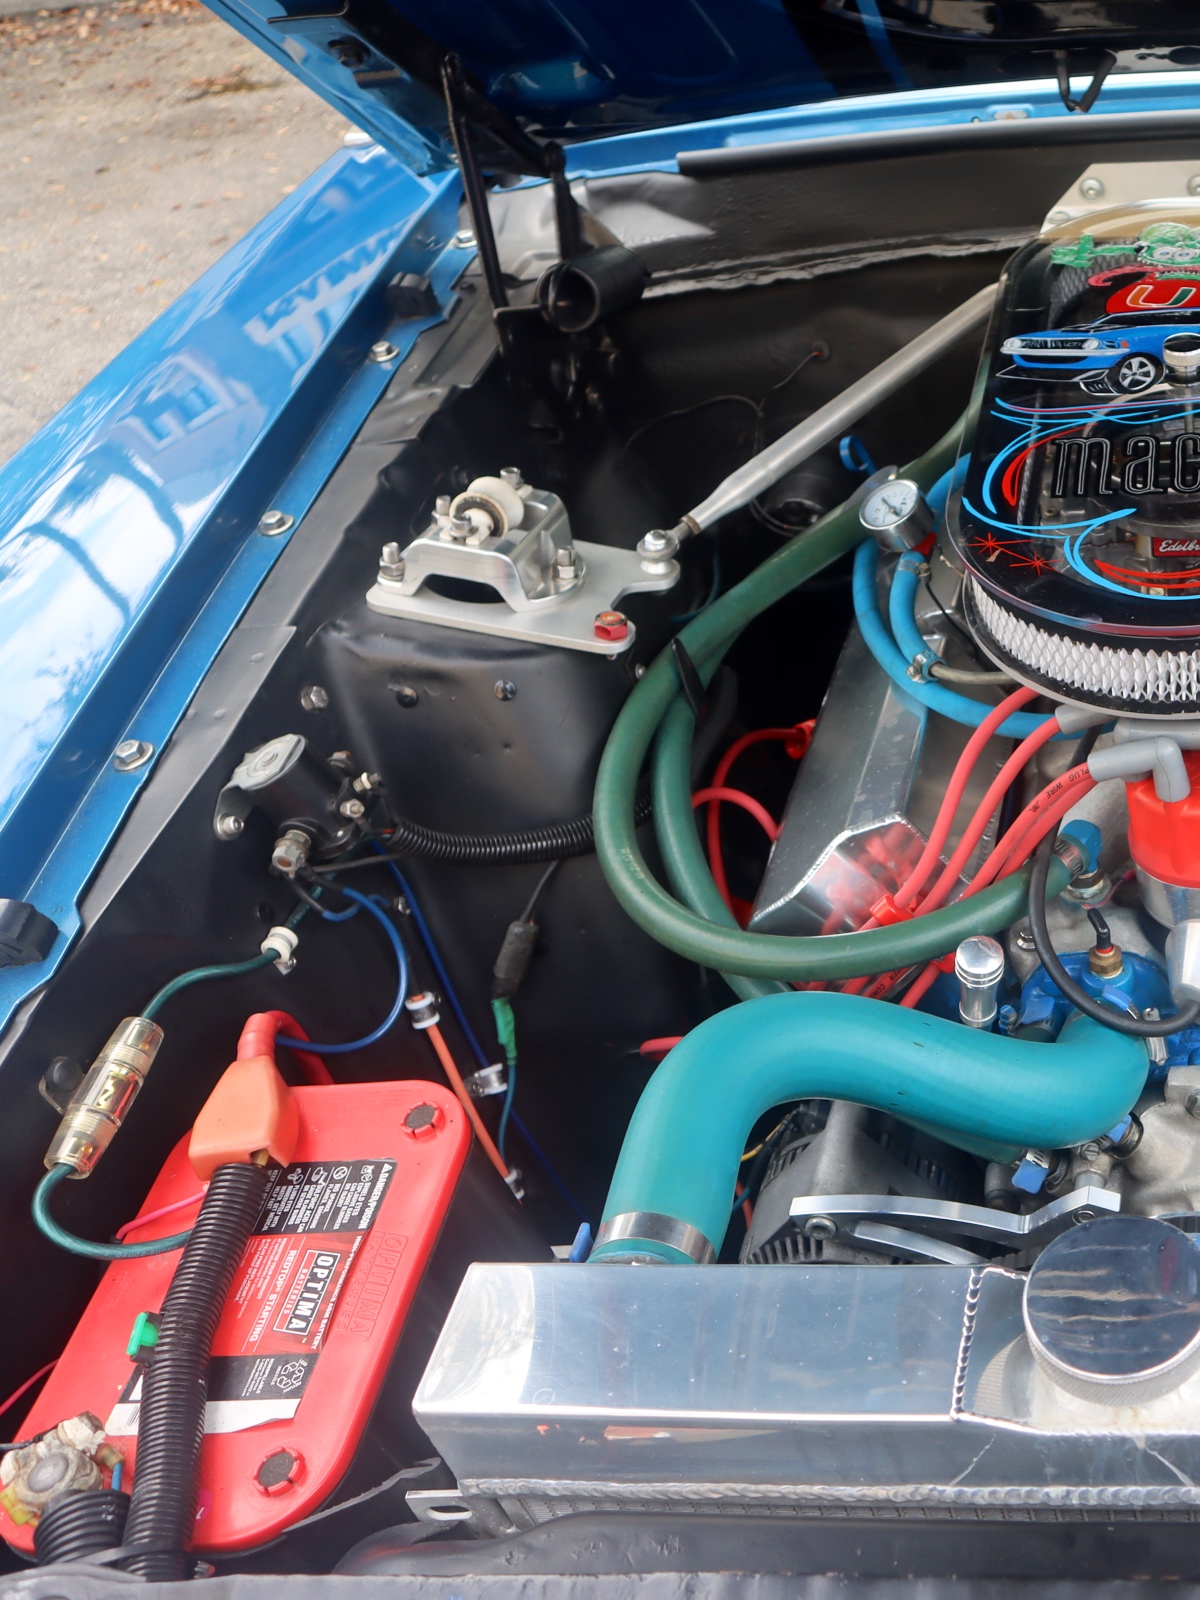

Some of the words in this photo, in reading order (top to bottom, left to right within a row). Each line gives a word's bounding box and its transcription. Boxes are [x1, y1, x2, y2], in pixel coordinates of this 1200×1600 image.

[1126, 285, 1197, 307] U
[1045, 782, 1063, 799] WIRE
[357, 1172, 389, 1229] DANGER/POISON
[358, 1181, 370, 1201] SHIELD
[352, 1201, 362, 1216] EYES
[267, 1262, 276, 1275] YOUR
[330, 1234, 362, 1303] HIGH-PERFORMANCE
[337, 1232, 381, 1331] BATTERIES
[257, 1275, 270, 1299] PRODUCT
[283, 1267, 308, 1314] BATTERIES
[288, 1254, 336, 1330] OPTIMA
[350, 1235, 403, 1335] OPTIMA
[249, 1293, 277, 1342] STARTING
[324, 1302, 334, 1319] AGM
[311, 1318, 327, 1349] BATTERY
